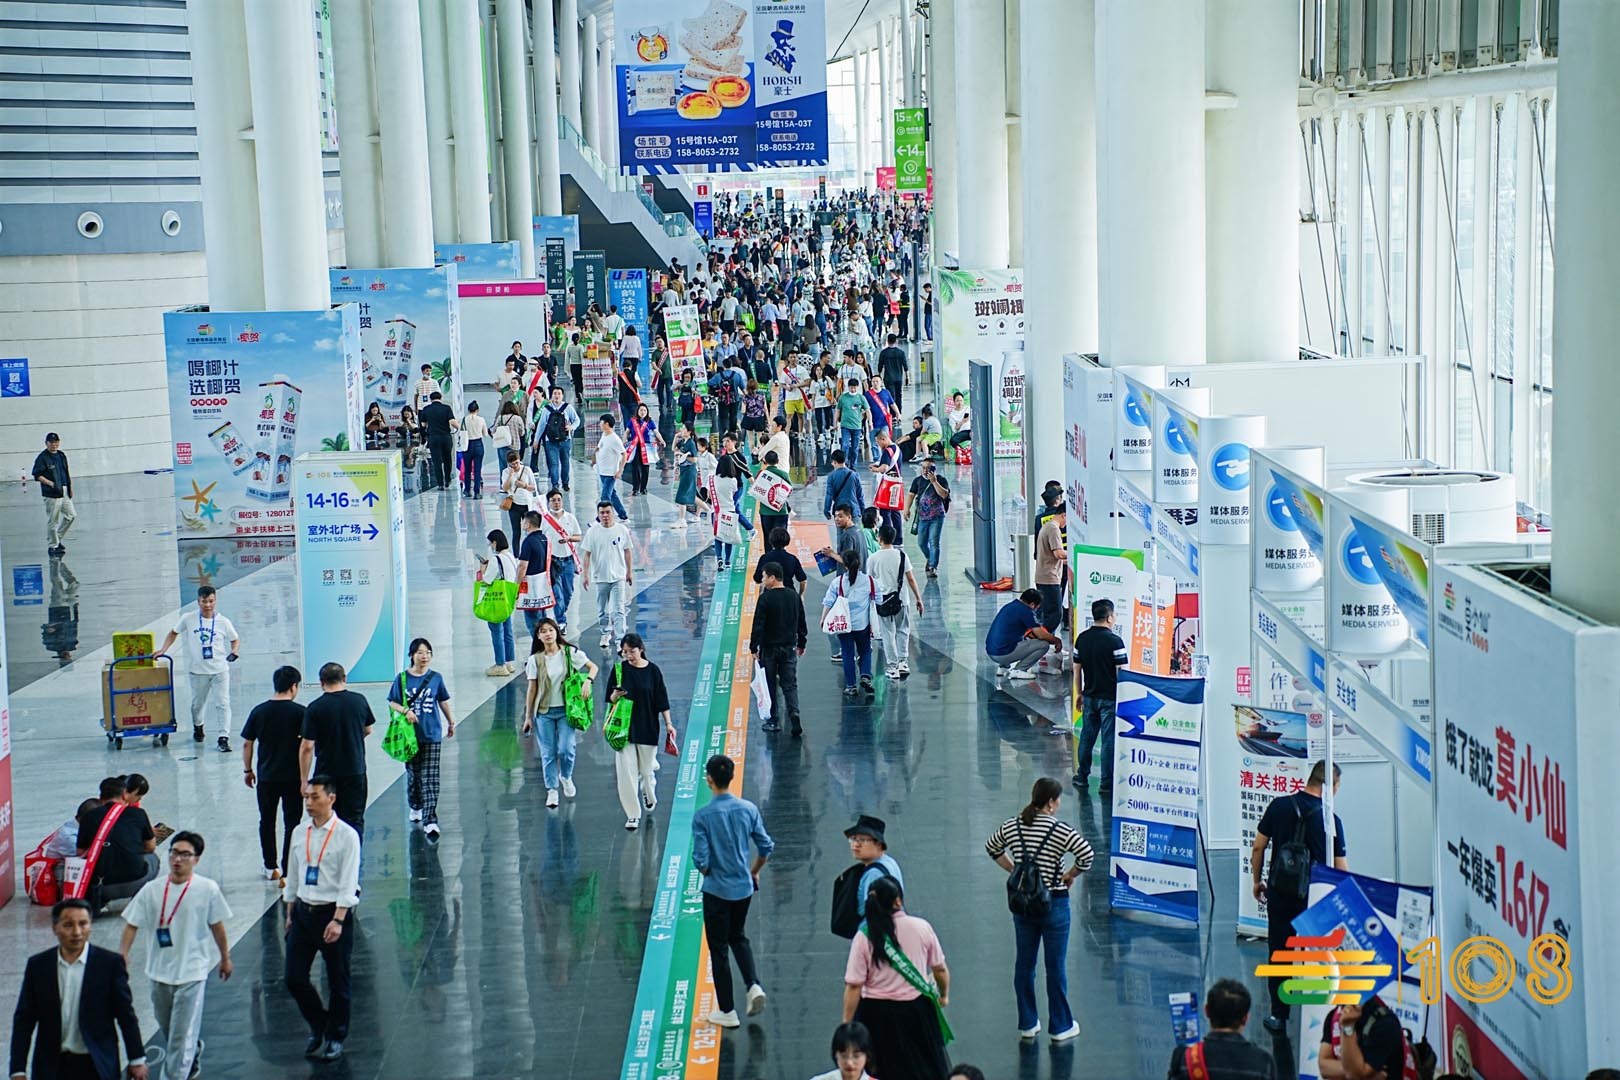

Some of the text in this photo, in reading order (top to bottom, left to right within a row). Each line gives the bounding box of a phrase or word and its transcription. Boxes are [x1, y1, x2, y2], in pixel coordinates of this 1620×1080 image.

[762, 76, 802, 86] HORSH
[773, 87, 793, 96] 豪士
[773, 110, 796, 119] 场馆号
[895, 111, 905, 122] 15
[756, 120, 812, 129] 15号馆15A-03T
[636, 136, 738, 146] 场馆号 15号馆15A-03T
[772, 133, 797, 142] 联系电话
[635, 147, 740, 158] 联系电话 158-8053-2732
[756, 142, 815, 152] 158-8053-2732
[906, 144, 919, 157] 14
[188, 359, 239, 377] 喝椰汁
[189, 378, 241, 396] 选椰贺
[306, 492, 349, 508] 14-16
[1210, 505, 1249, 516] 媒体服务
[308, 524, 361, 536] 室外北广场
[1342, 619, 1366, 628] MEDIA
[1240, 770, 1306, 794] 清关报关
[1148, 843, 1194, 859] 加入行业交流
